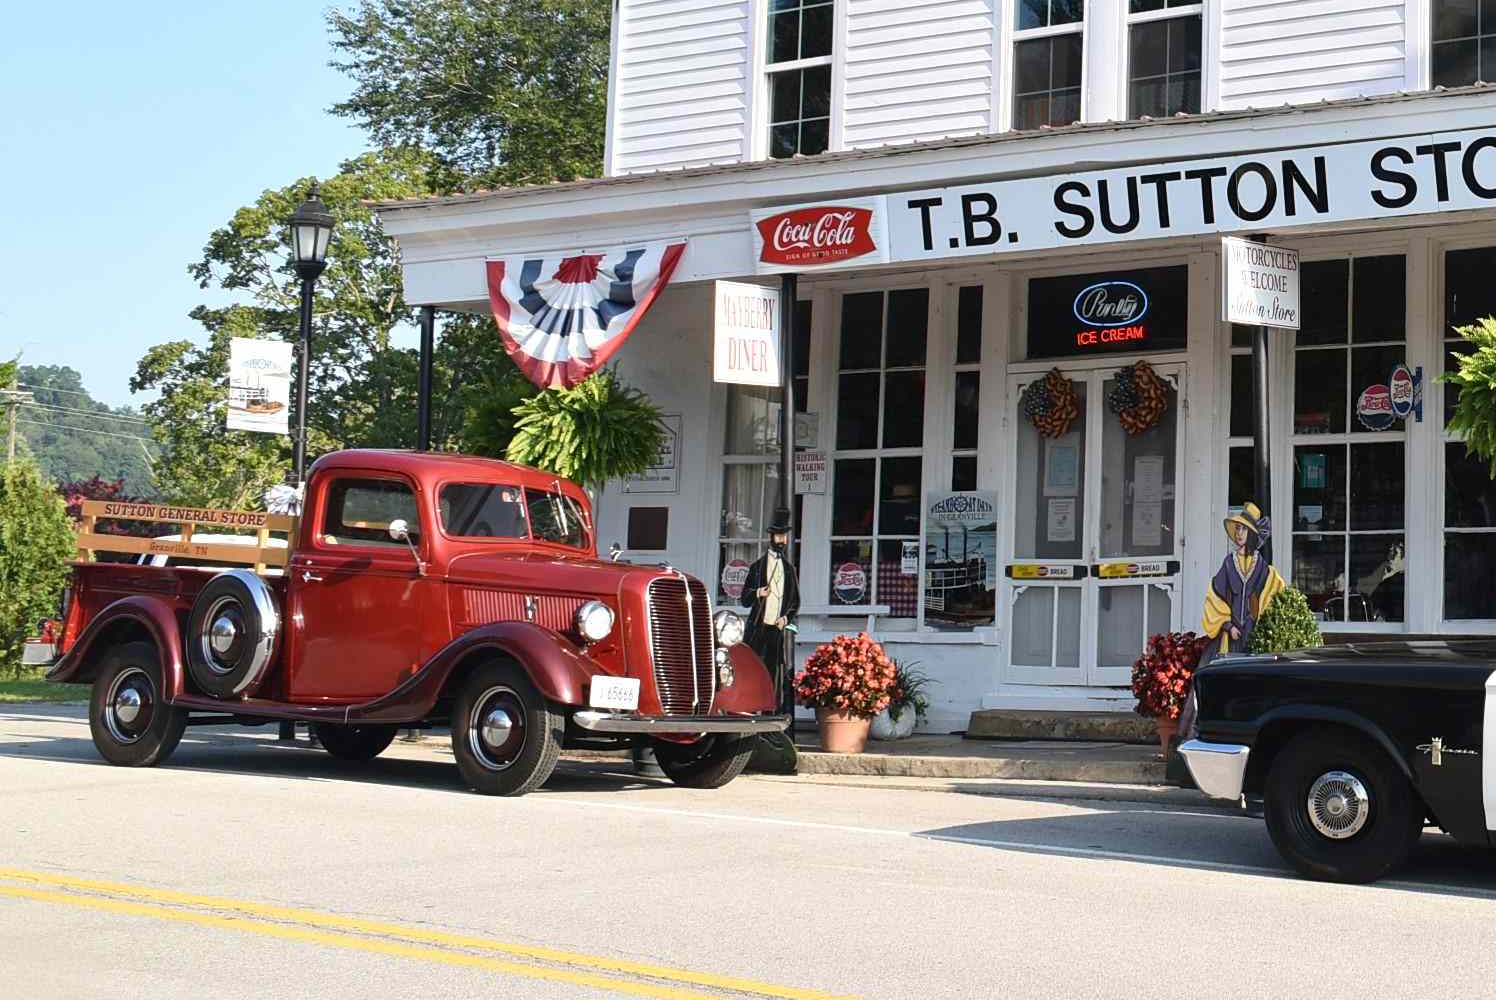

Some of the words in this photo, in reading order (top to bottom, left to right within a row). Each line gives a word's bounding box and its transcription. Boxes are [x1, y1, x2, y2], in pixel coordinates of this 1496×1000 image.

[908, 192, 1019, 251] T.B.
[1052, 156, 1330, 239] SUTTON
[724, 293, 776, 330] MAYBERRY
[1268, 296, 1297, 321] Store
[1077, 331, 1097, 345] ICE
[1101, 326, 1143, 342] CREAM
[728, 337, 768, 372] DINER
[801, 473, 818, 481] TOUR
[104, 504, 155, 518] SUTTON
[158, 507, 217, 523] GENERAL
[221, 511, 265, 526] STORE
[195, 546, 208, 555] TN
[1050, 568, 1067, 576] BREAD
[1140, 564, 1160, 572] BREAD
